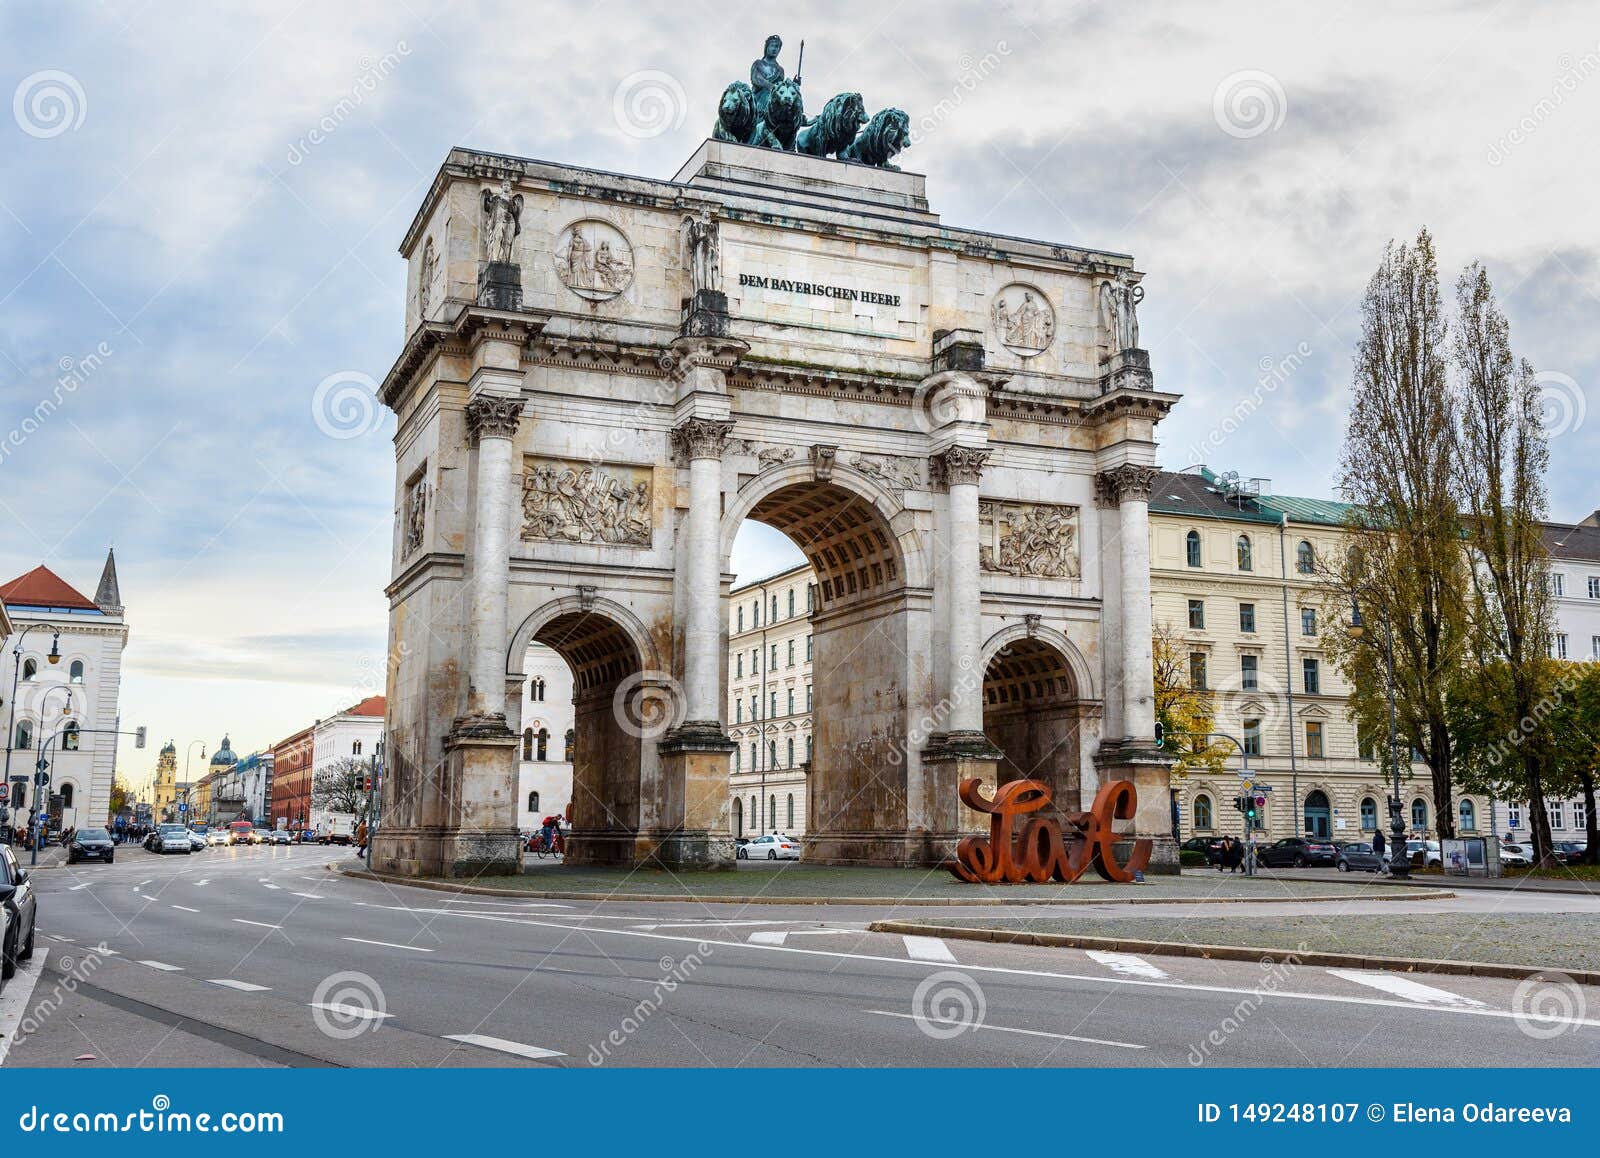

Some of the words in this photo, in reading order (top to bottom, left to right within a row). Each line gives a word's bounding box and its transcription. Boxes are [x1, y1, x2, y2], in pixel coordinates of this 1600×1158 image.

[739, 273, 768, 288] DEM
[771, 278, 858, 300] BAYERISCHEN
[860, 291, 901, 307] HEERE
